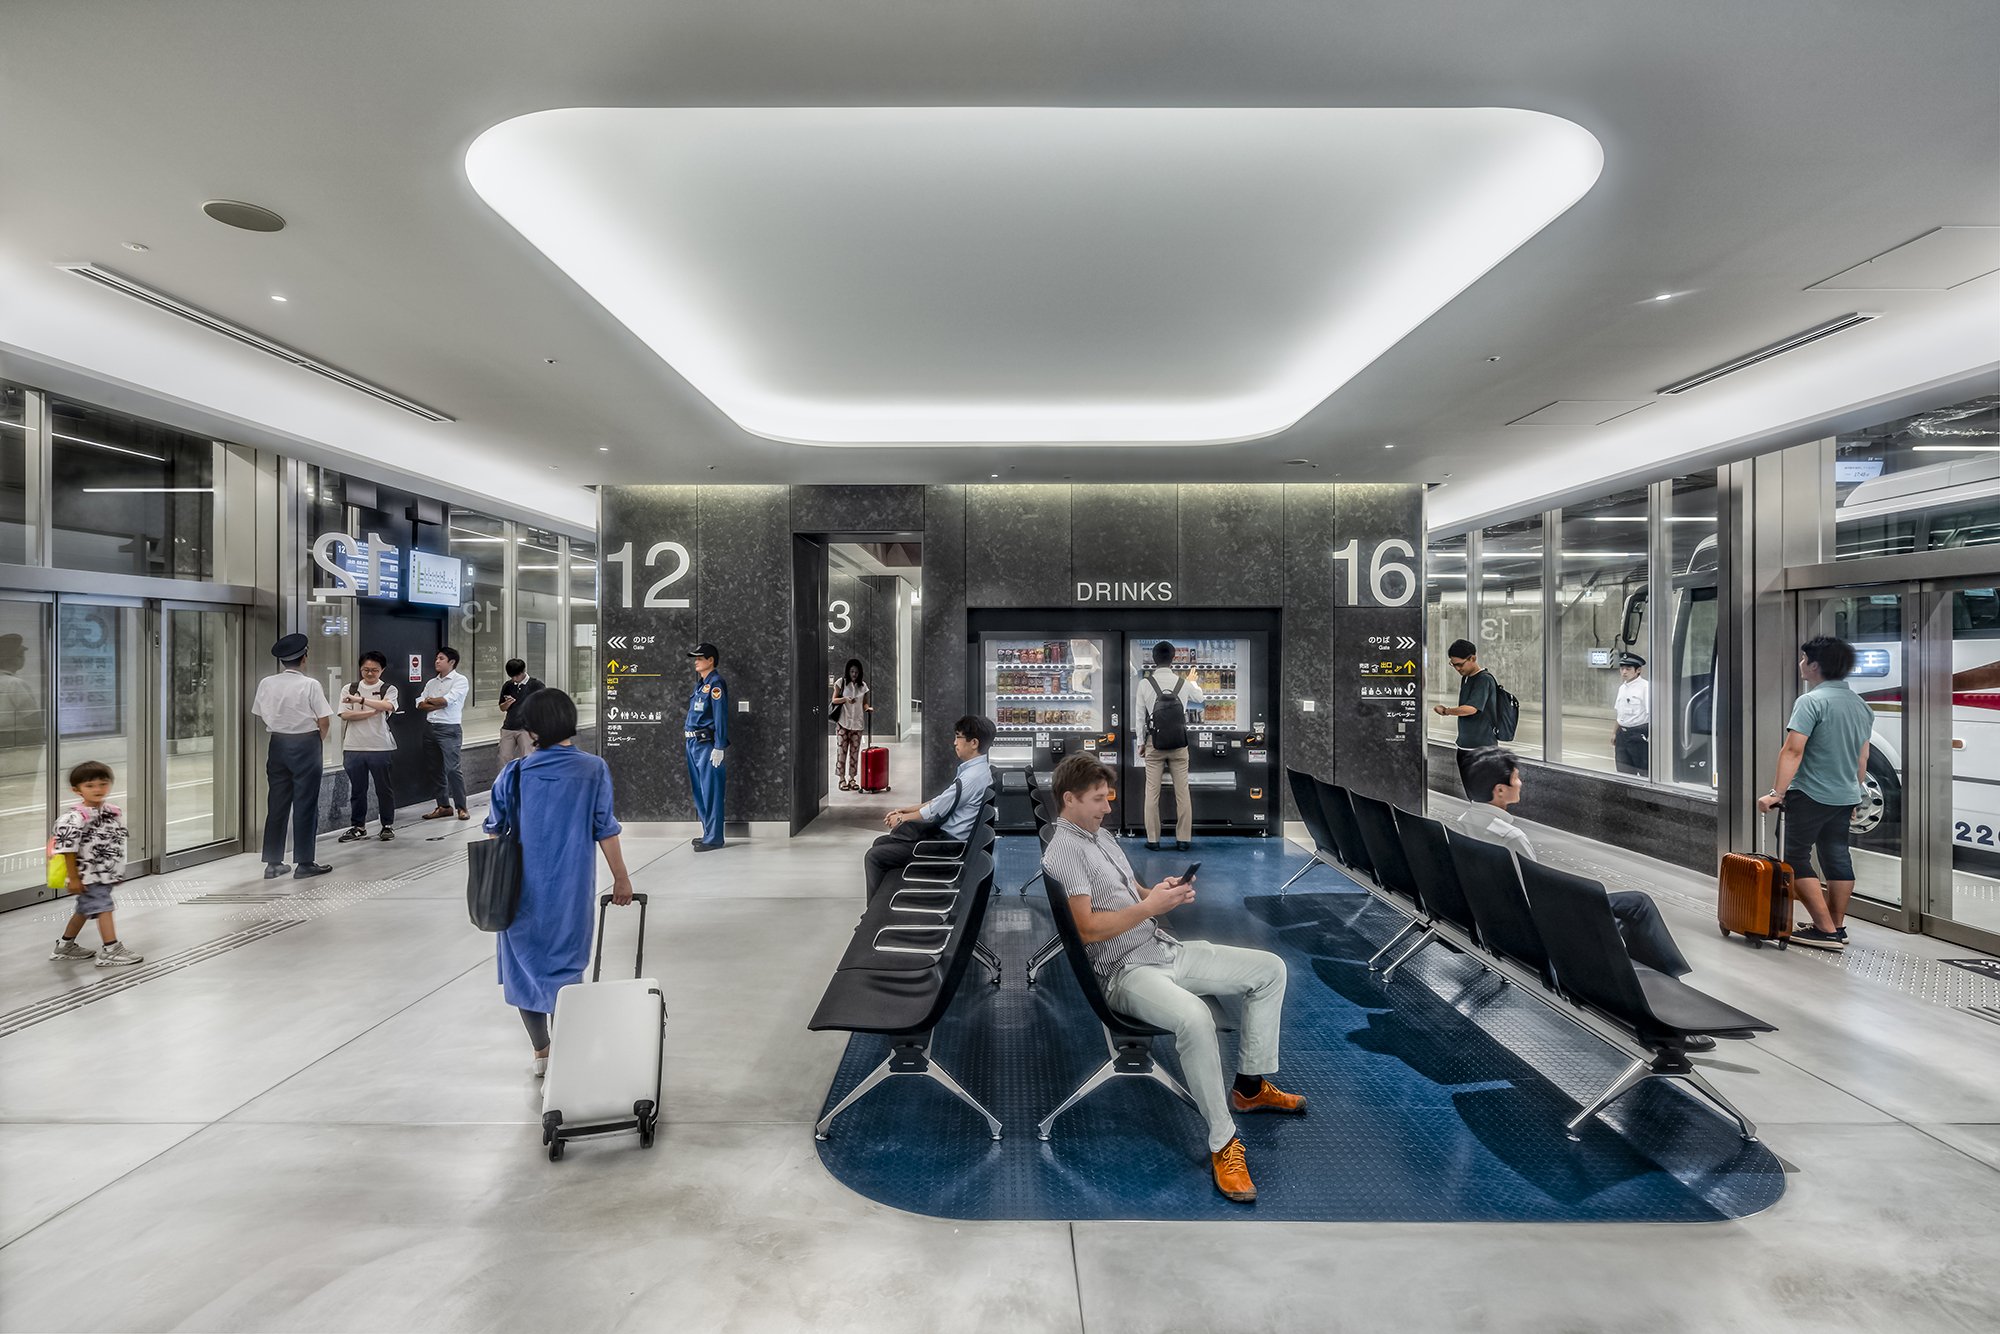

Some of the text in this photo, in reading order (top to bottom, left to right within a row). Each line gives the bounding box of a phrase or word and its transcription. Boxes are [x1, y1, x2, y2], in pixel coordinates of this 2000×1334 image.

[337, 545, 346, 554] 12
[607, 541, 690, 608] 12
[1332, 538, 1416, 607] 16
[1077, 582, 1172, 601] DRINKS
[1954, 821, 2000, 847] 22
